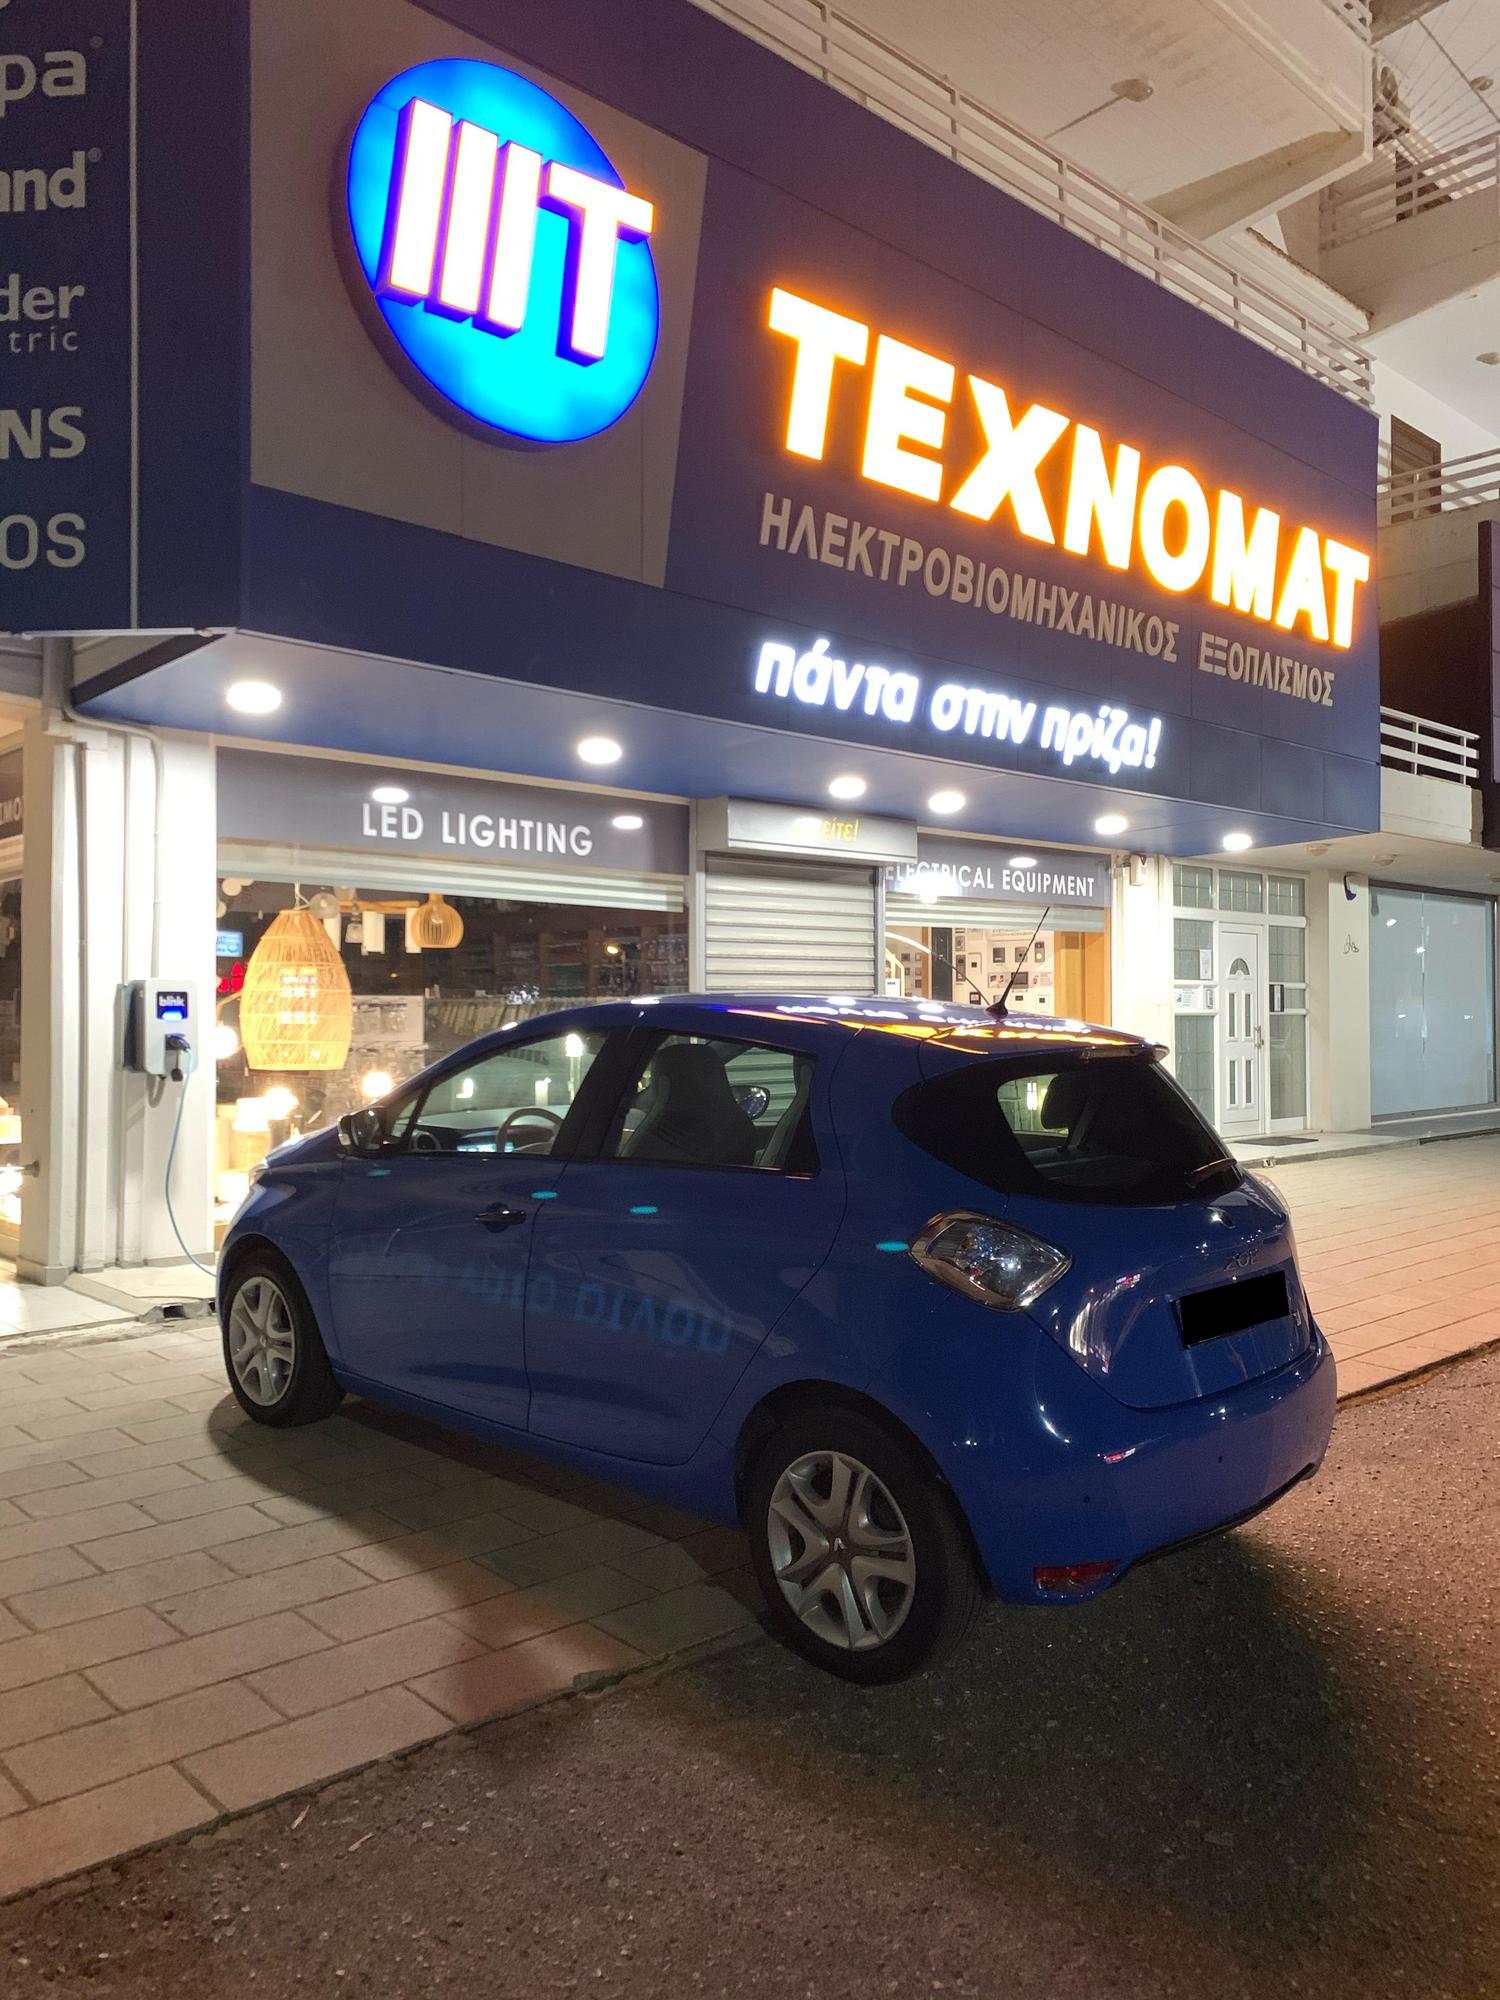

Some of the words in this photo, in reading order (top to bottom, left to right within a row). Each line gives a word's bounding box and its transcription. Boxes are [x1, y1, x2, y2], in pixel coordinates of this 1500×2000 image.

[758, 492, 1180, 663] ΗΛΕΚΤΡΟΒΙΟΜΗΧΑΝΙΚΟΣ
[1198, 631, 1335, 708] ΕΞΟΠΛΙΣΜΟΣ
[755, 638, 919, 722] πάντα
[930, 684, 1037, 744] στην
[1040, 704, 1162, 773] πρίζα!
[363, 803, 424, 840] LED
[442, 811, 593, 856] LIGHTING
[1002, 869, 1095, 896] EQUIPMENT
[158, 995, 186, 1007] blink
